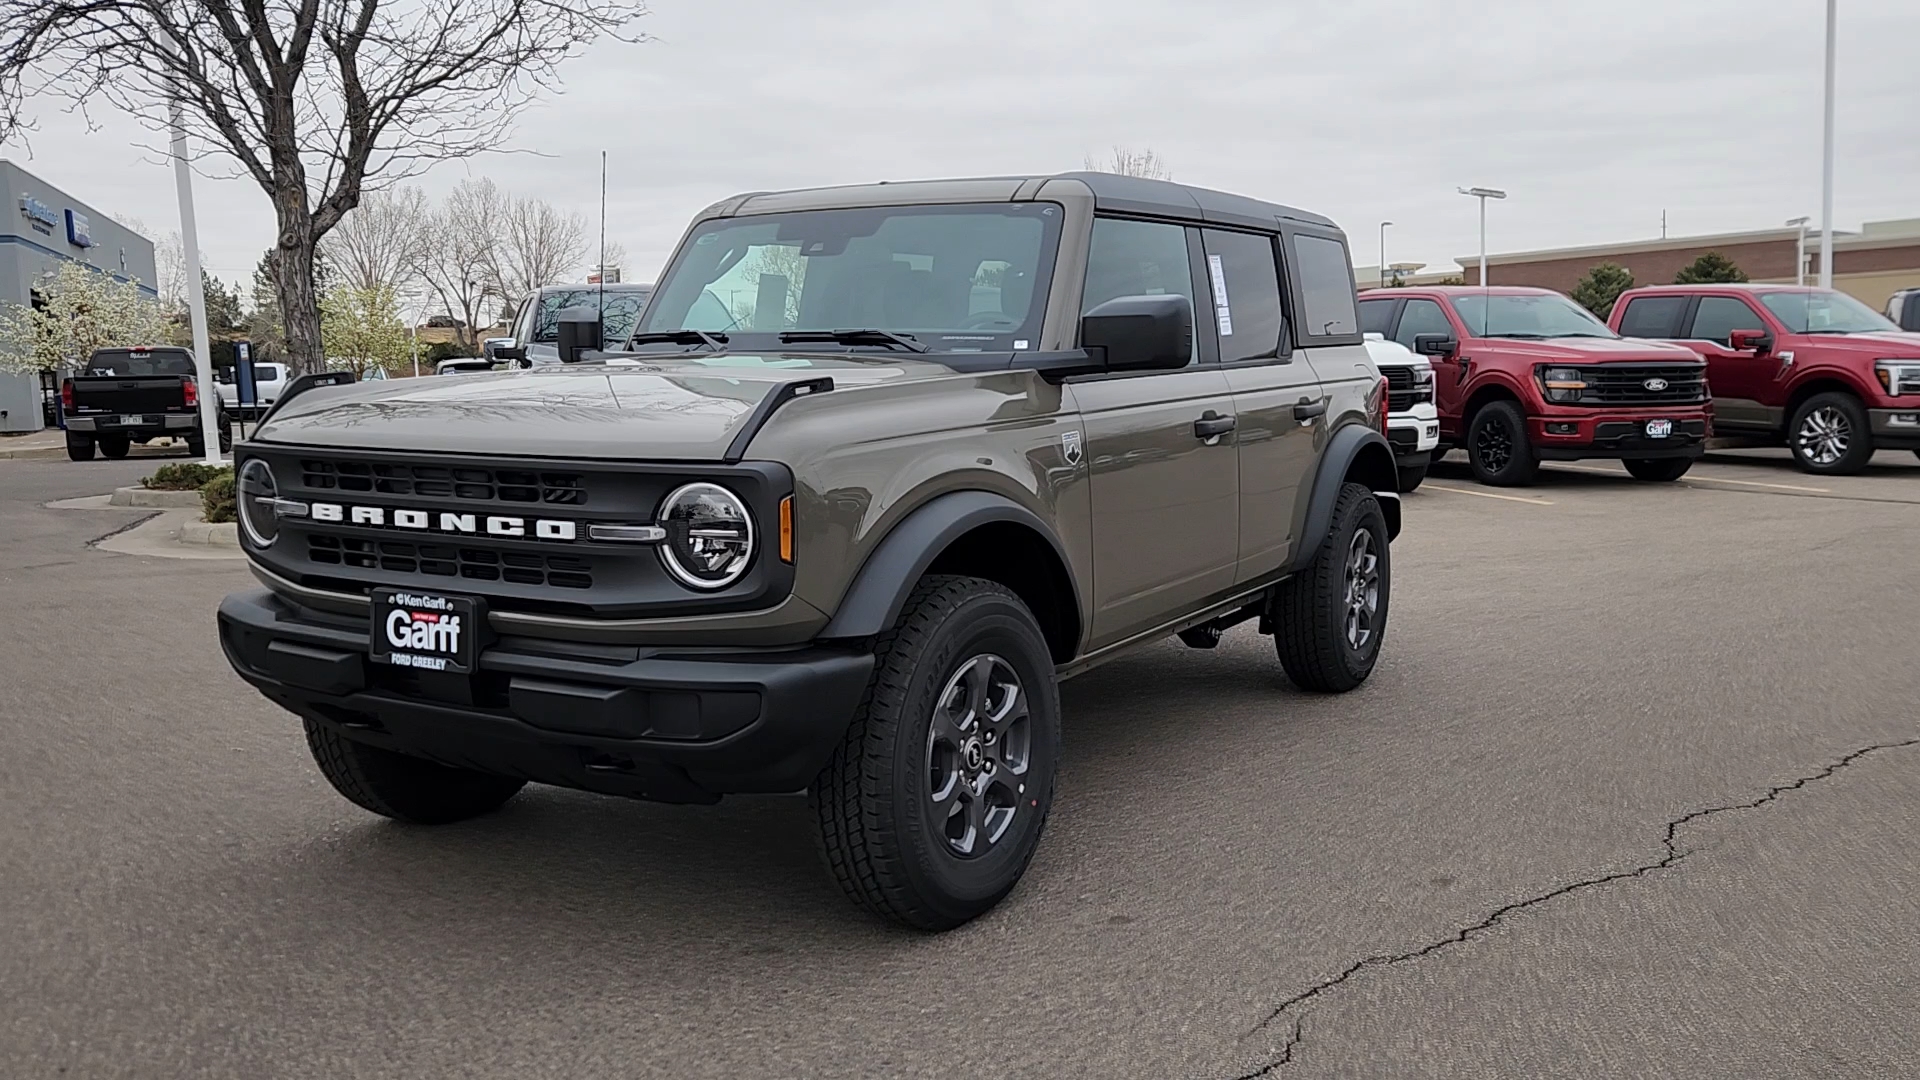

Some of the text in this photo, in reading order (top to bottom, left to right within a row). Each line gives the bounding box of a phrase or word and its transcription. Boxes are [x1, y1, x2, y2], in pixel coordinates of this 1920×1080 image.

[1646, 421, 1672, 435] Garff
[311, 502, 577, 540] BRONCO
[404, 593, 446, 610] Ken Garff
[386, 608, 460, 653] Garff
[391, 653, 446, 670] FORD GREELEY
